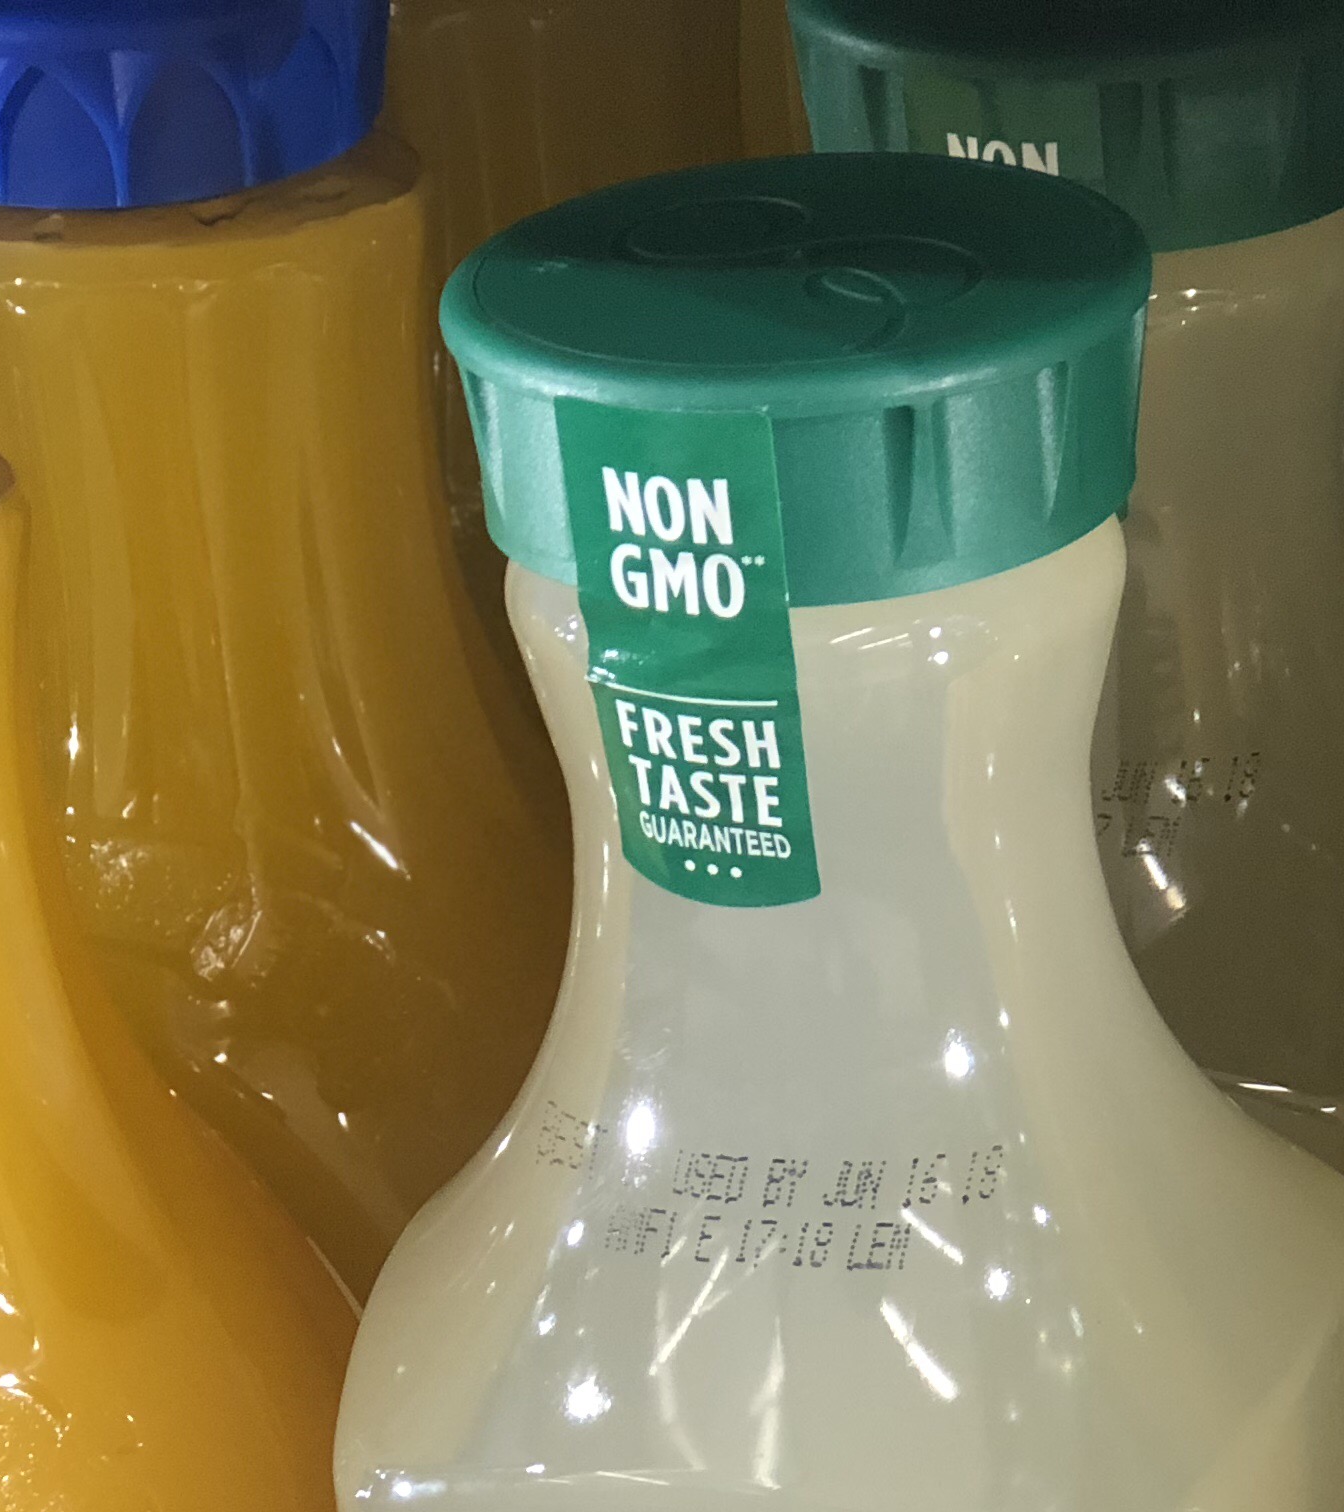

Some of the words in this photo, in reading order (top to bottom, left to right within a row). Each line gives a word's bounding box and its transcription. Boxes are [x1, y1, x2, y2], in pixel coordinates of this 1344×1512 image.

[602, 466, 734, 546] NON
[615, 698, 781, 769] FRESH
[628, 754, 783, 828] TASTE
[639, 814, 791, 860] GUARANTEED
[763, 1158, 810, 1208] BY
[823, 1160, 887, 1210] JUN
[902, 1152, 947, 1208] 16
[961, 1144, 1004, 1205] 18
[694, 1215, 722, 1263] E
